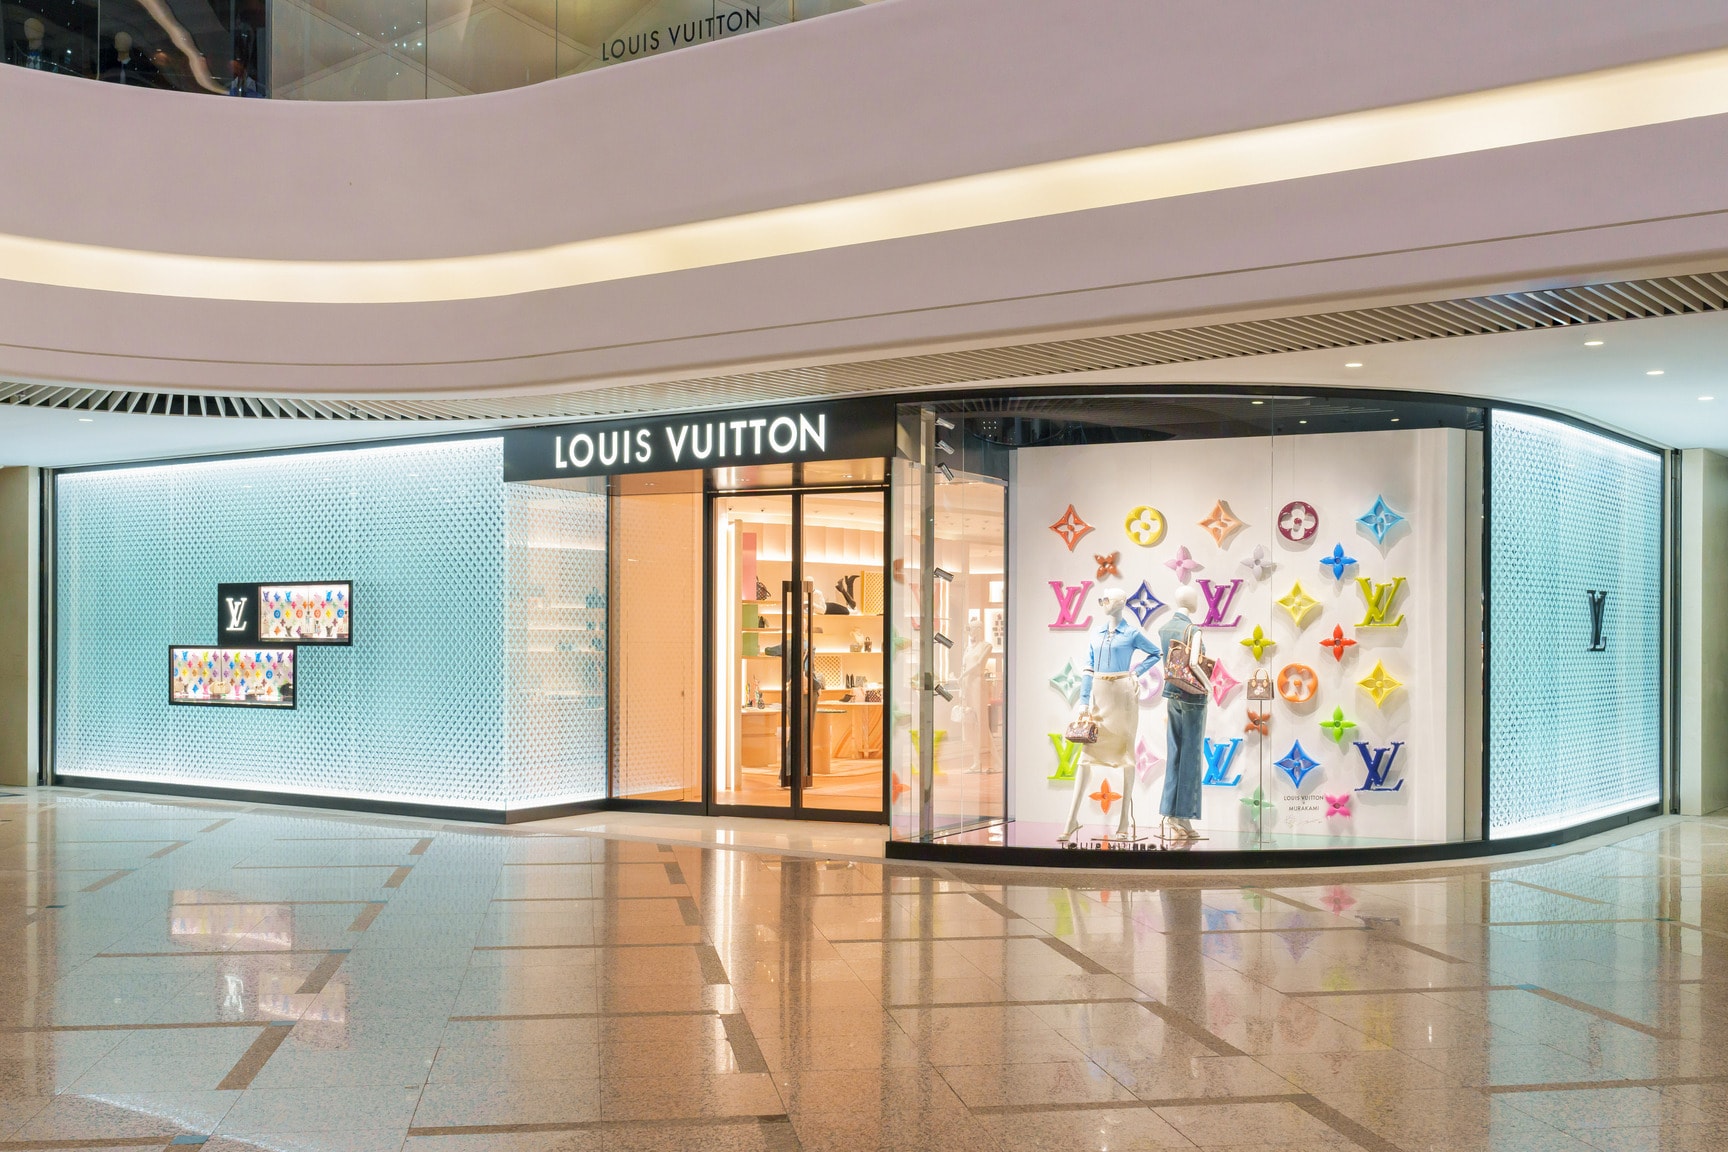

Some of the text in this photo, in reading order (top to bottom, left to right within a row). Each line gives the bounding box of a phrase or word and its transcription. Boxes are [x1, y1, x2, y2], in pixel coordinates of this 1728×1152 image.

[602, 6, 760, 62] LOUIS VUITTON
[555, 413, 826, 469] LOUIS VUITTON
